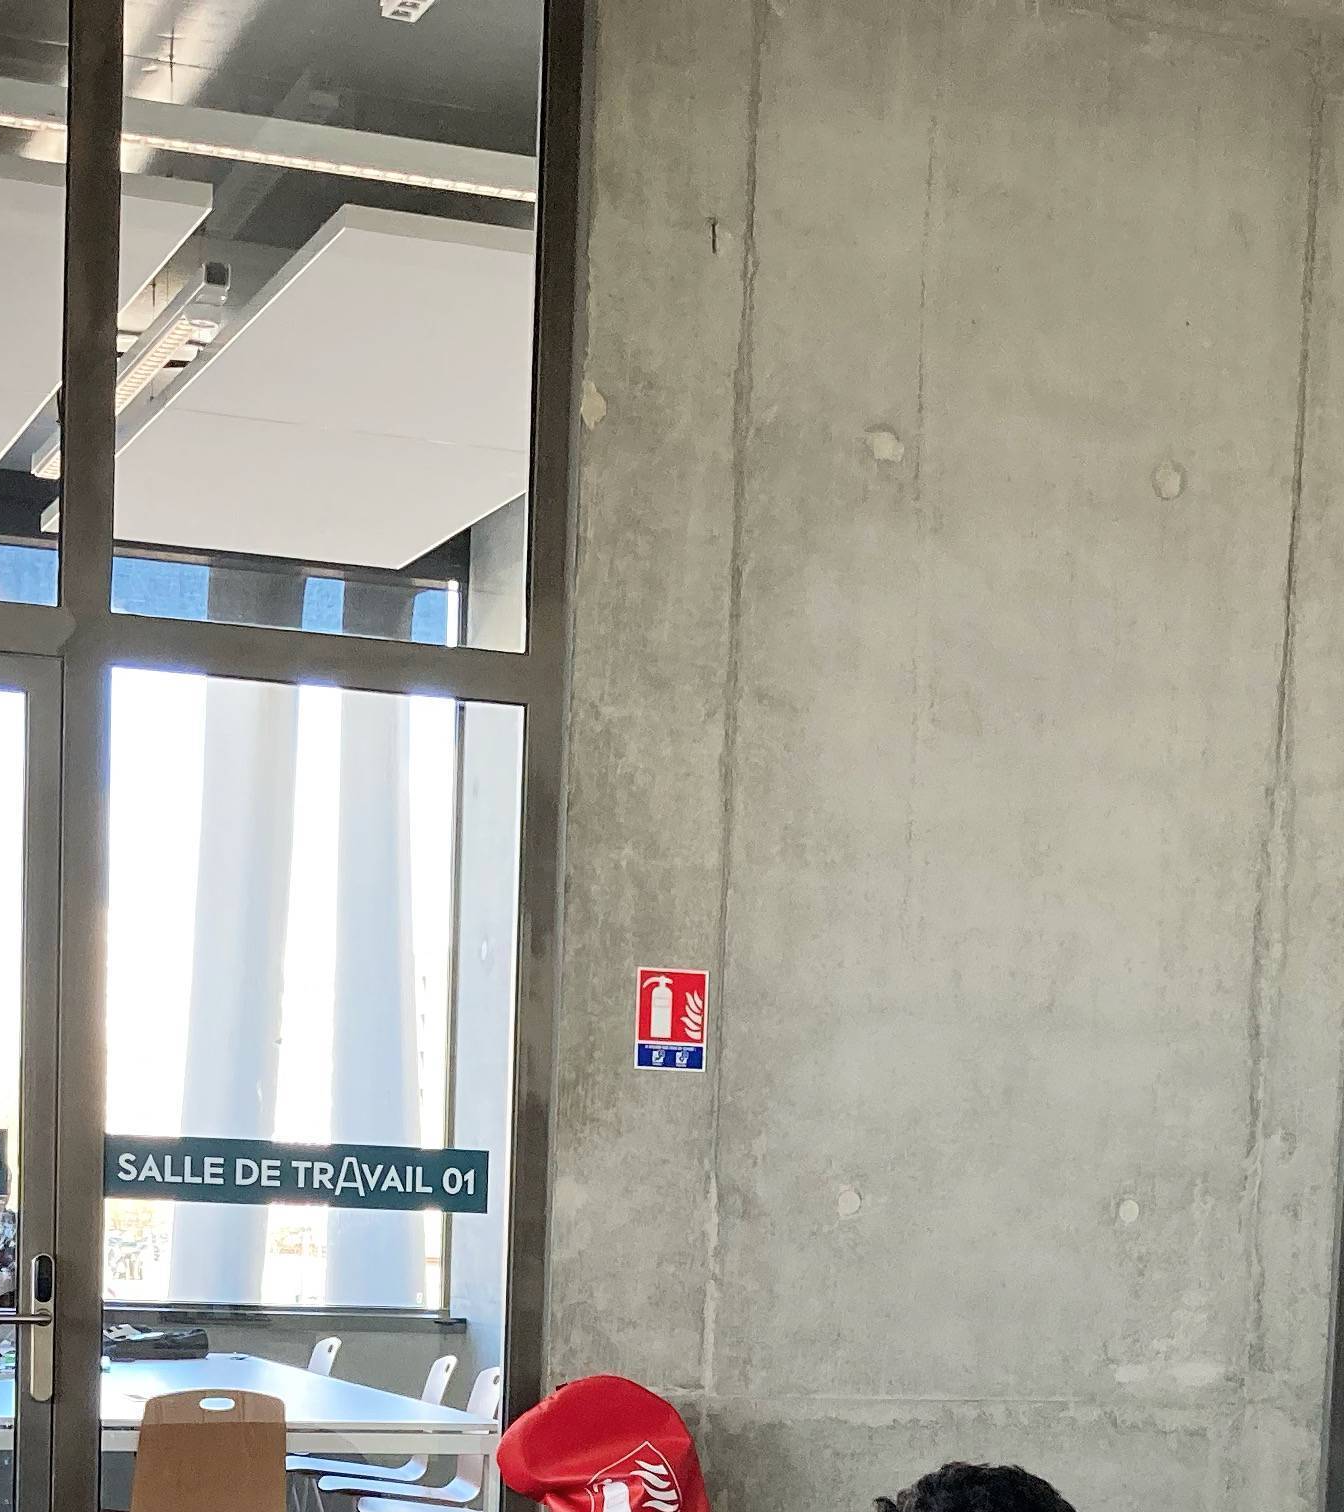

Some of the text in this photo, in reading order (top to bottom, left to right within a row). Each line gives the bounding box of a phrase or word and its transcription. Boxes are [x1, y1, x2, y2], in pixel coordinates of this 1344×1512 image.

[117, 1152, 475, 1197] SALLE DE TRAVAIL 01
